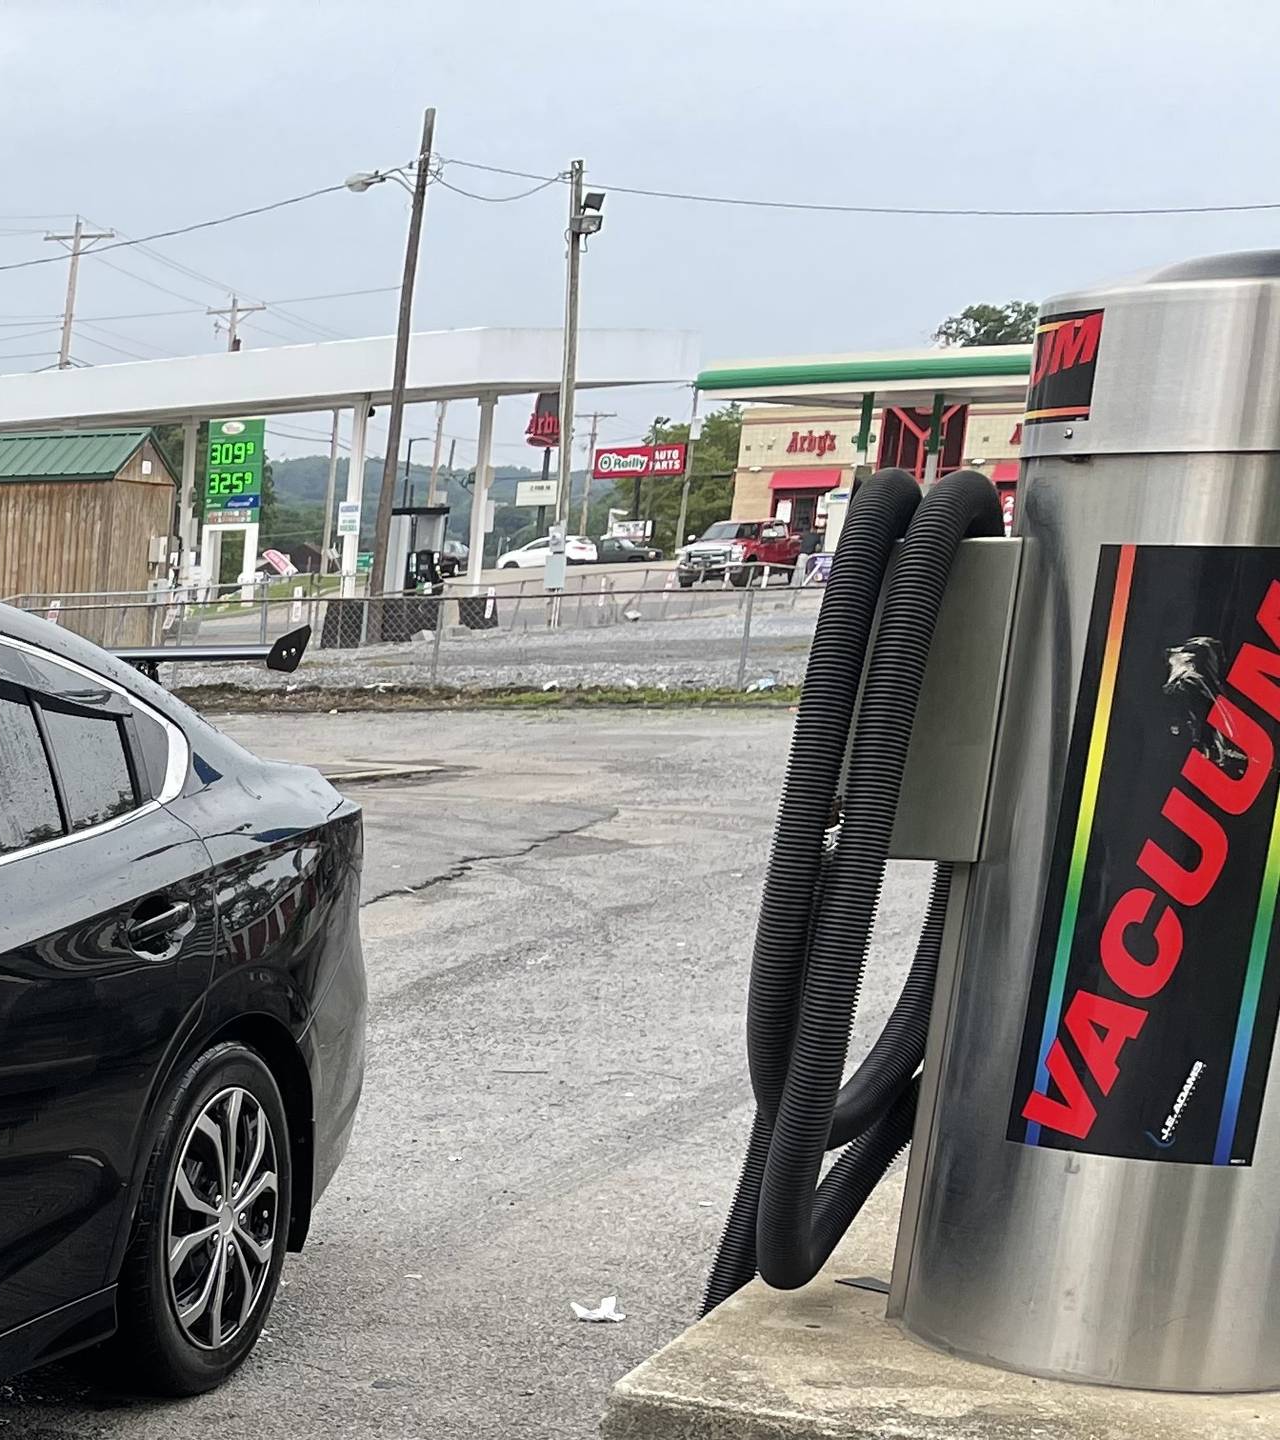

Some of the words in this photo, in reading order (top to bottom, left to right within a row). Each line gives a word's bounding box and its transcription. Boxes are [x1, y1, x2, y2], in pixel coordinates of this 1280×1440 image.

[786, 430, 837, 457] Arby's
[599, 452, 648, 473] O'Reilly
[654, 449, 680, 460] AUTO
